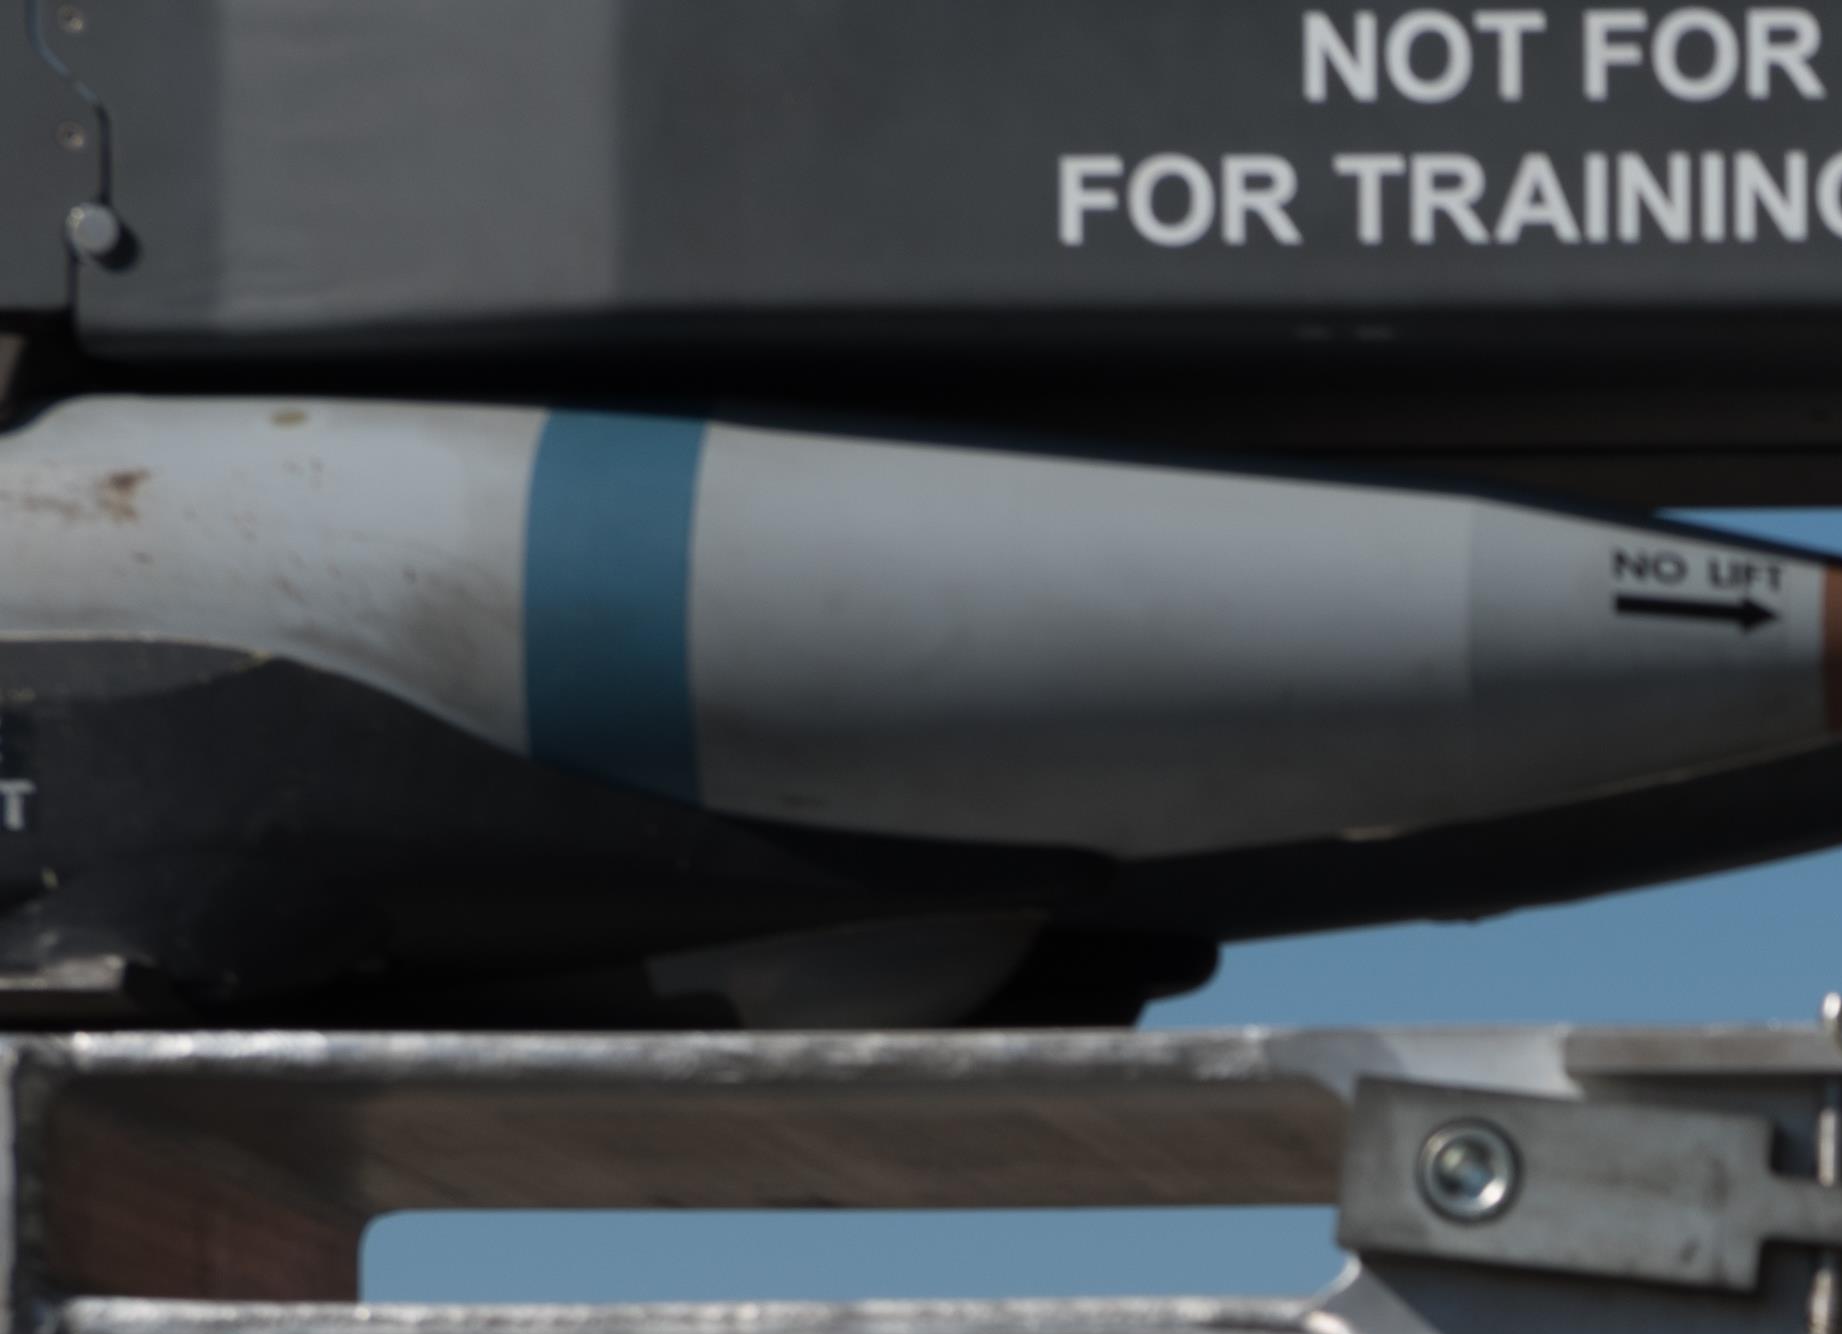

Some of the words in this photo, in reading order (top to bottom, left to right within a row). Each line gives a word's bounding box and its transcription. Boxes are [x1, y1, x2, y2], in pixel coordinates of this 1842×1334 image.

[1303, 10, 1547, 103] NOT
[1582, 7, 1826, 101] FOR
[1057, 153, 1302, 246] FOR
[1611, 550, 1688, 585] NO
[1707, 557, 1784, 592] LIFT
